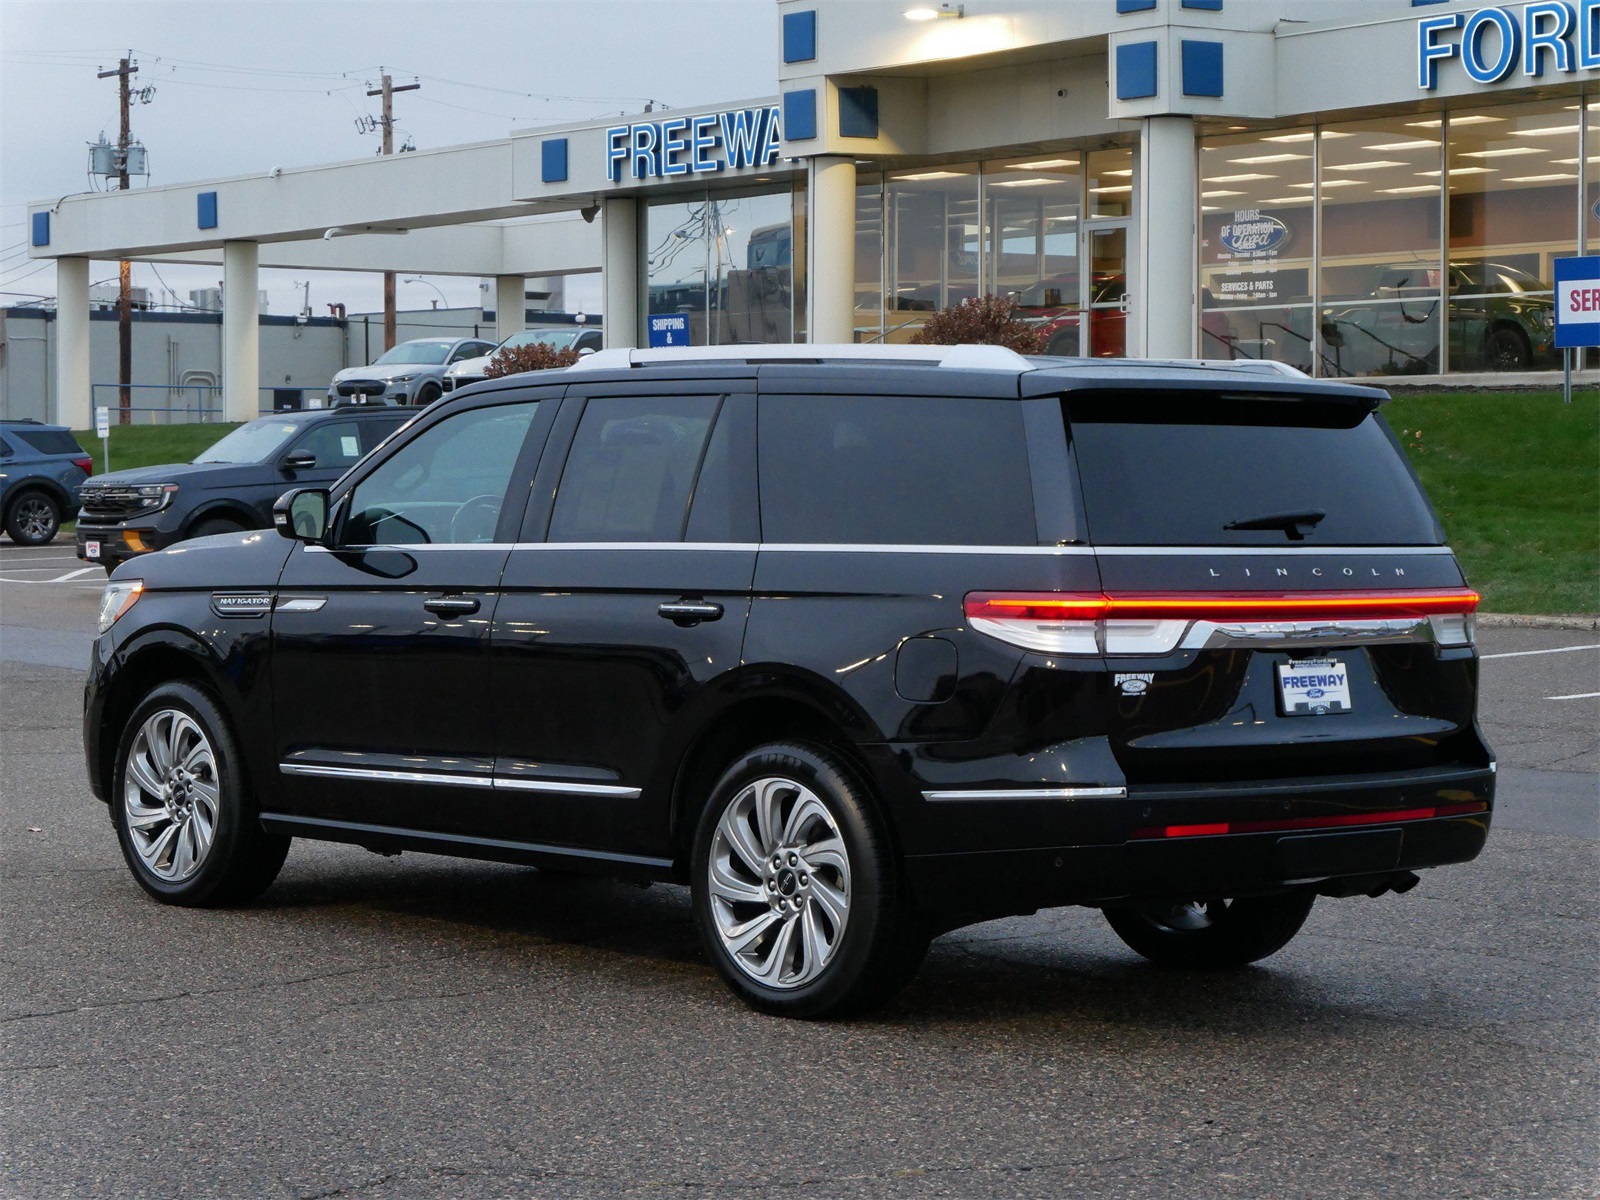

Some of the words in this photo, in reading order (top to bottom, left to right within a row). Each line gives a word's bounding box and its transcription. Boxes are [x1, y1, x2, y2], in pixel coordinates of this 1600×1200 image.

[1234, 209, 1260, 222] HOURS
[1221, 225, 1231, 237] OF
[1232, 222, 1274, 236] OPERATION
[1221, 282, 1248, 292] SERVICES
[1249, 282, 1254, 290] &
[1254, 280, 1274, 290] PARTS
[652, 317, 685, 330] SHIPPING
[666, 332, 672, 344] &
[1209, 568, 1405, 577] LINCOLN
[220, 597, 270, 605] NAVIGATOR
[1115, 672, 1155, 687] FREEWAY
[1282, 673, 1345, 689] FREEWAY
